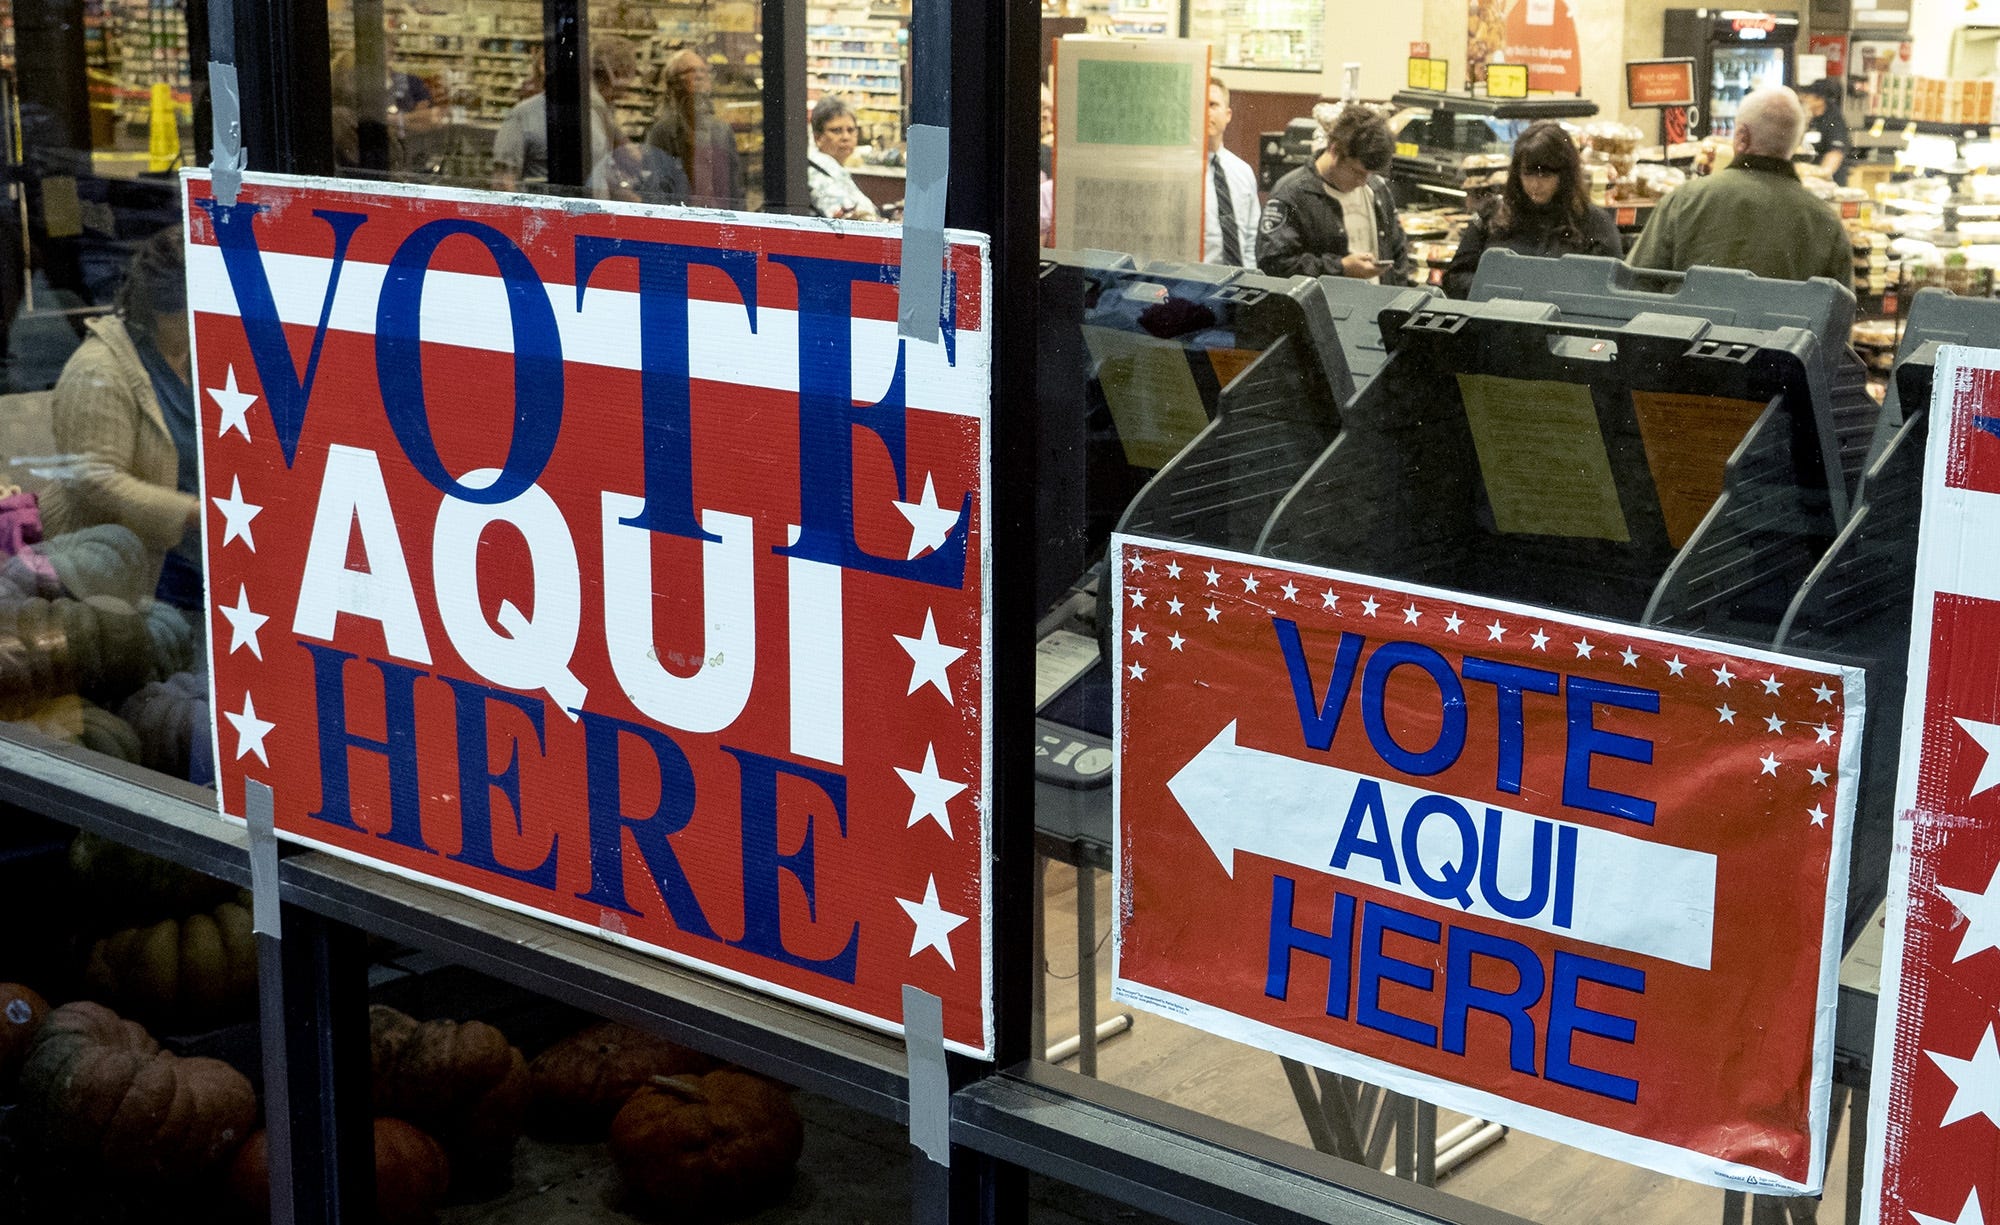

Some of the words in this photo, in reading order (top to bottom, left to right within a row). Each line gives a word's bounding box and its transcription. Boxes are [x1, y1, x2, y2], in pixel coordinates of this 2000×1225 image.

[195, 199, 973, 590] VOTE
[292, 443, 843, 766] AQUI
[1272, 617, 1660, 826] VOTE
[297, 641, 860, 984] HERE
[1329, 778, 1578, 928] AQUI
[1264, 875, 1645, 1104] HERE
